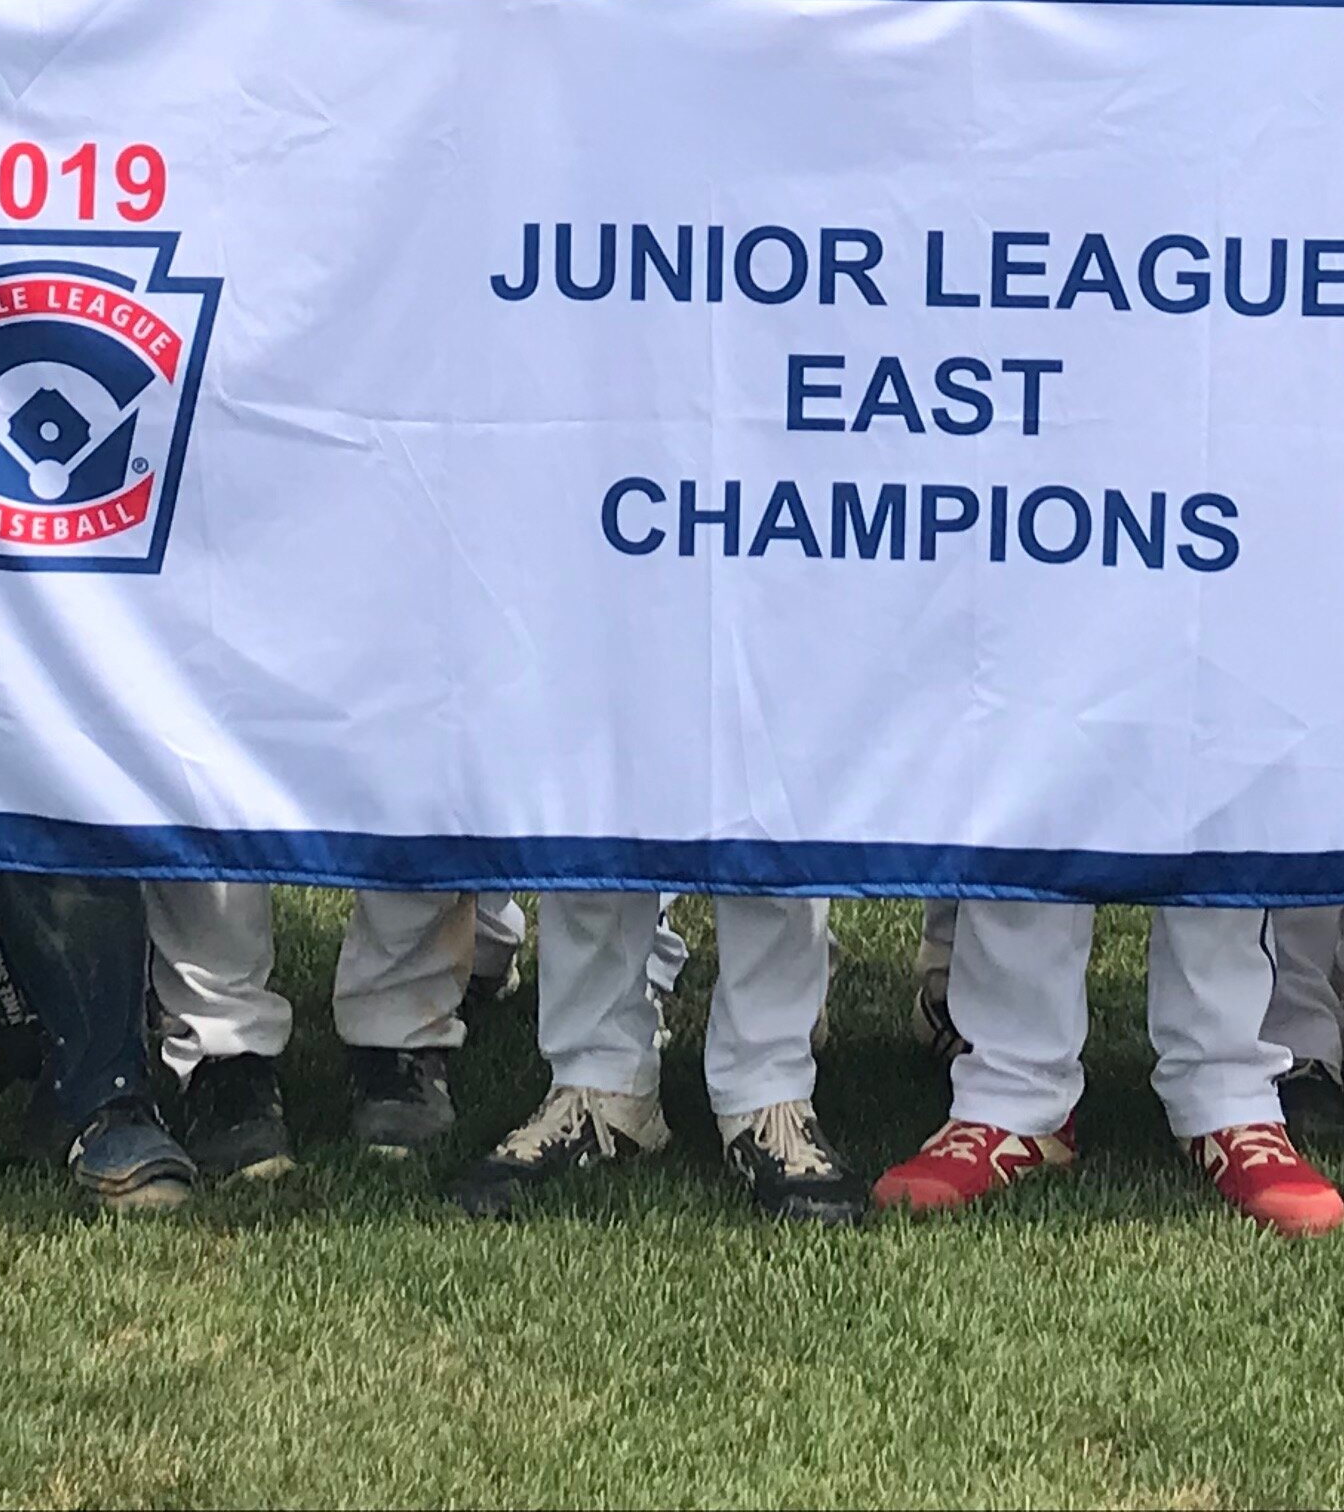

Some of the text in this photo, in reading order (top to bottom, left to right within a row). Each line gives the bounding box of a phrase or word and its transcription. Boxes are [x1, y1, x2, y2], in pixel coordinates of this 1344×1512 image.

[489, 222, 888, 307] JUNIOR
[47, 284, 174, 356] LEAGUE
[785, 353, 1064, 437] EAST
[600, 476, 1241, 573] CHAMPIONS
